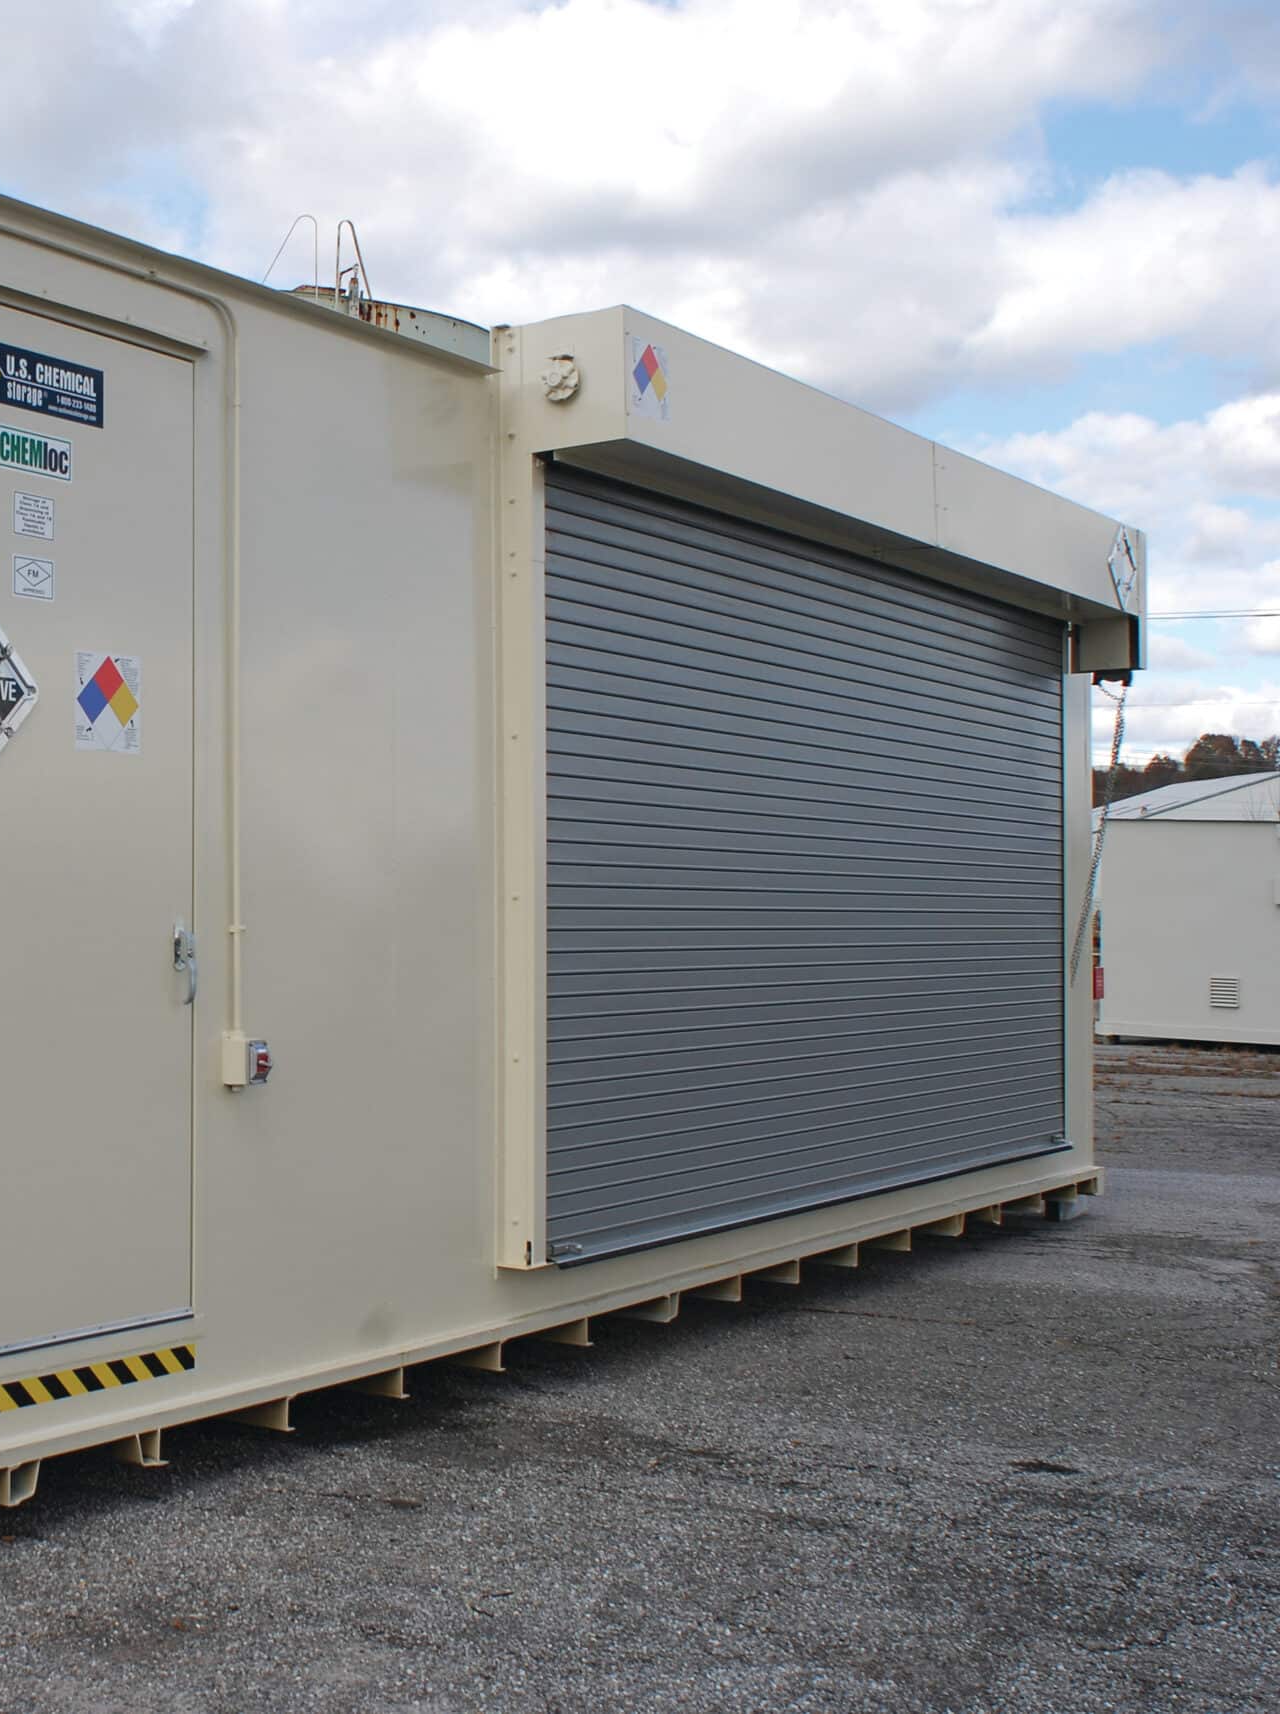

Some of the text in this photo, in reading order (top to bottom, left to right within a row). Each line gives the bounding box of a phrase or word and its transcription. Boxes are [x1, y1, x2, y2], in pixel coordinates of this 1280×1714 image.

[6, 354, 97, 397] U.S. CHEMICAL
[7, 381, 43, 407] storage
